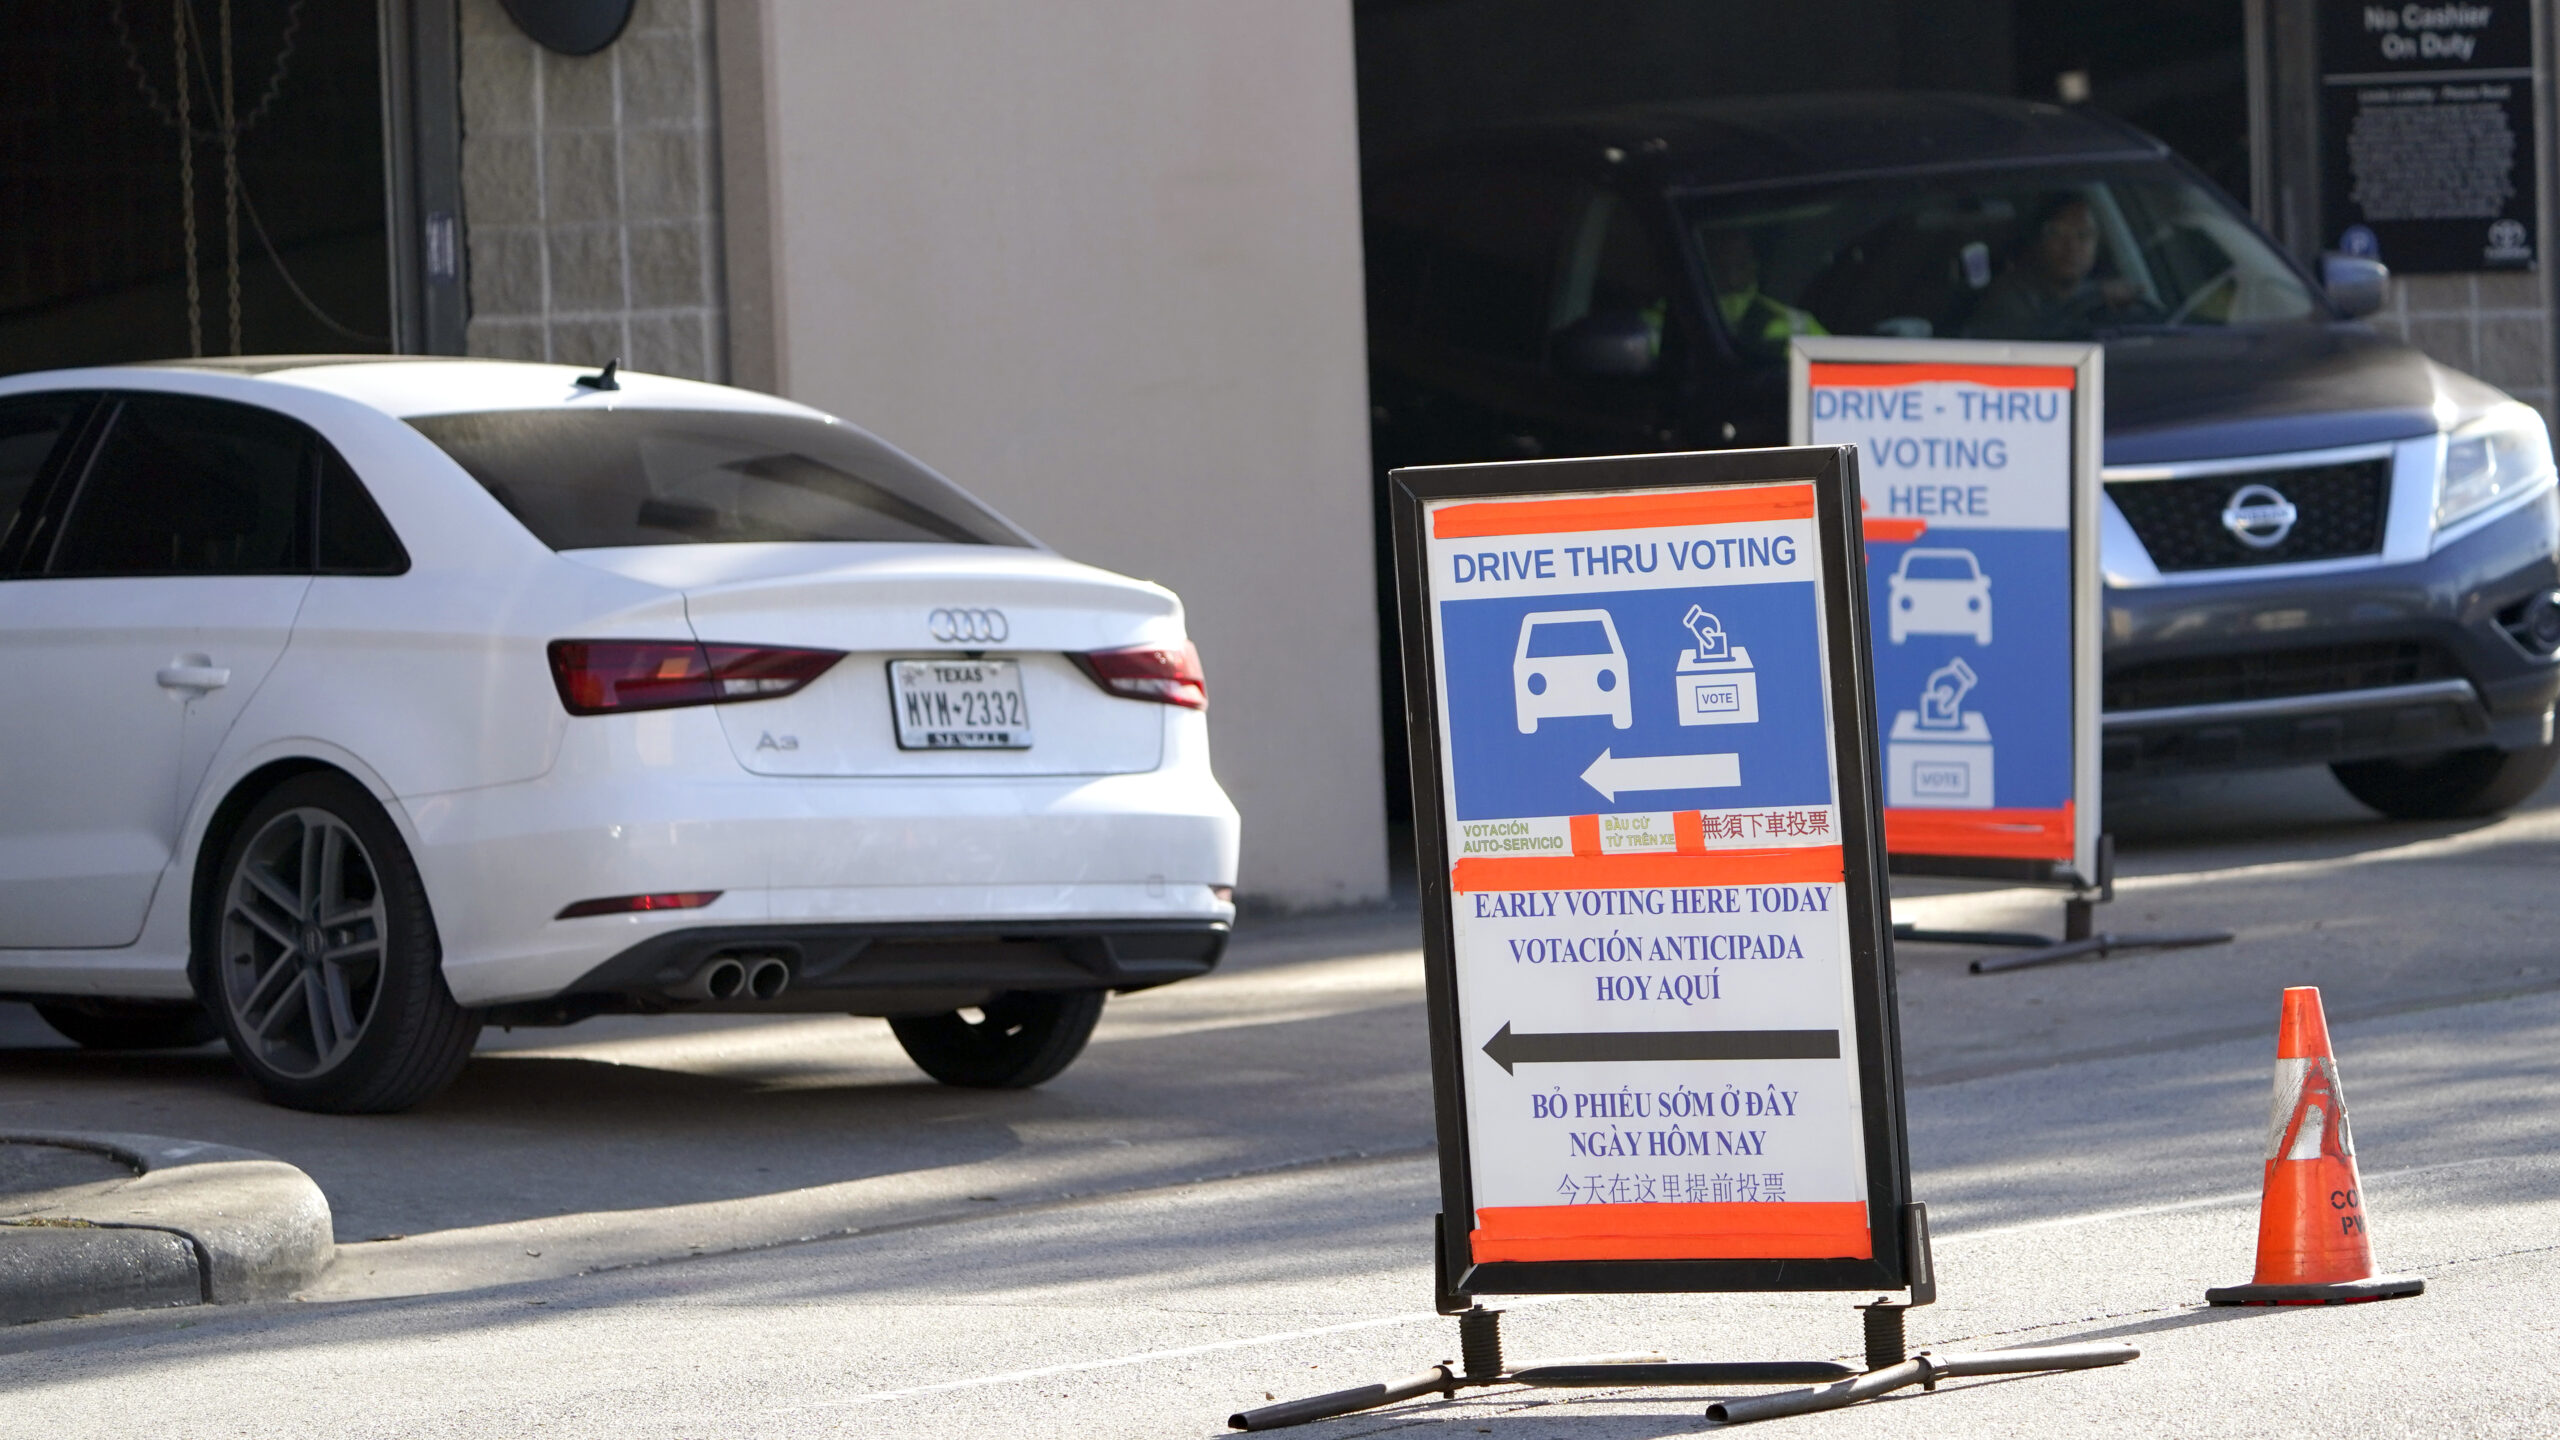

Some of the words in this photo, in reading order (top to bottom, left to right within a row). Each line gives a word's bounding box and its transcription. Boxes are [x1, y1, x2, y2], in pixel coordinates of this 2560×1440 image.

[2364, 6, 2398, 31] No
[2402, 3, 2492, 30] Cashier
[2381, 33, 2417, 59] On
[2421, 32, 2476, 62] Duty
[1815, 390, 1923, 420] DRIVE
[1957, 391, 2058, 422] THRU
[1870, 438, 2008, 469] VOTING
[1889, 486, 1989, 516] HERE
[1453, 548, 1556, 583] DRIVE
[1565, 542, 1658, 577] THRU
[1667, 535, 1797, 572] VOTING
[933, 668, 983, 684] TEXAS
[1702, 692, 1733, 704] VOTE
[756, 731, 799, 751] A3
[1921, 773, 1960, 786] VOTE
[1463, 820, 1529, 838] VOTACIÓN
[1627, 832, 1657, 847] TRÊN
[1660, 833, 1675, 846] XE
[1701, 810, 1830, 839] 無須下車投票
[1463, 836, 1563, 853] AUTO-SERVICIO
[1474, 890, 1559, 918] EARLY
[1564, 889, 1664, 915] VOTING
[1671, 888, 1740, 914] HERE
[1745, 886, 1832, 912] TODAY
[1508, 929, 1643, 964] VOTACIÓN
[1649, 934, 1804, 961] ANTICIPADA
[1596, 975, 1653, 1002] HOY
[1656, 966, 1721, 1006] AQUÍ
[1532, 1086, 1568, 1119] BỎ
[1659, 1084, 1715, 1117] SỚM
[1721, 1084, 1741, 1117] Ở
[1746, 1084, 1799, 1117] ĐÂY
[1569, 1124, 1642, 1157] NGÀY
[1649, 1123, 1709, 1156] HÔM
[1716, 1131, 1767, 1156] NAY
[1556, 1172, 1787, 1205] 今天在这里提前投票
